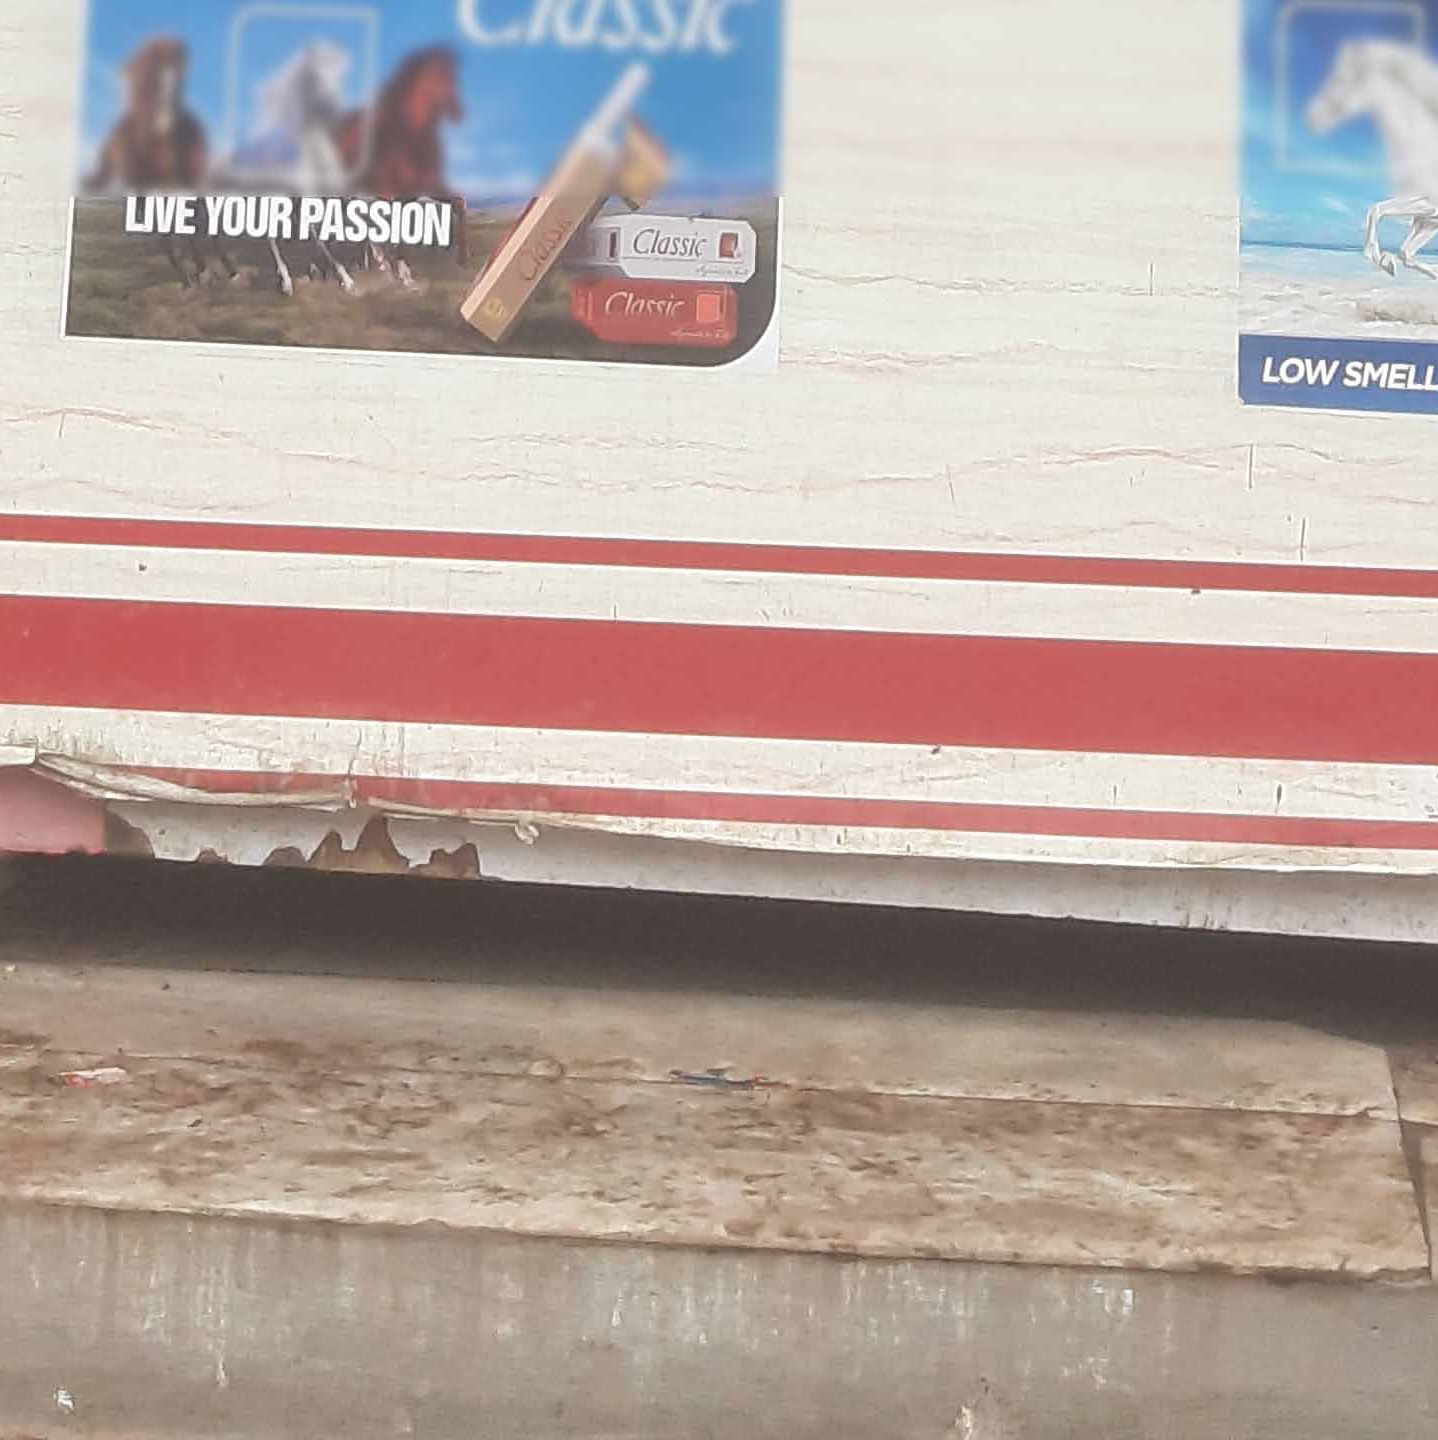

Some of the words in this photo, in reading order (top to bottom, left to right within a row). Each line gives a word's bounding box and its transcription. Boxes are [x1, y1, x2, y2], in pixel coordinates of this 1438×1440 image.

[124, 196, 197, 235] LIVE
[204, 197, 293, 241] YOUR
[299, 197, 451, 246] PASSION
[633, 229, 707, 257] Classic
[605, 291, 686, 318] Classic
[1263, 357, 1340, 386] LOW
